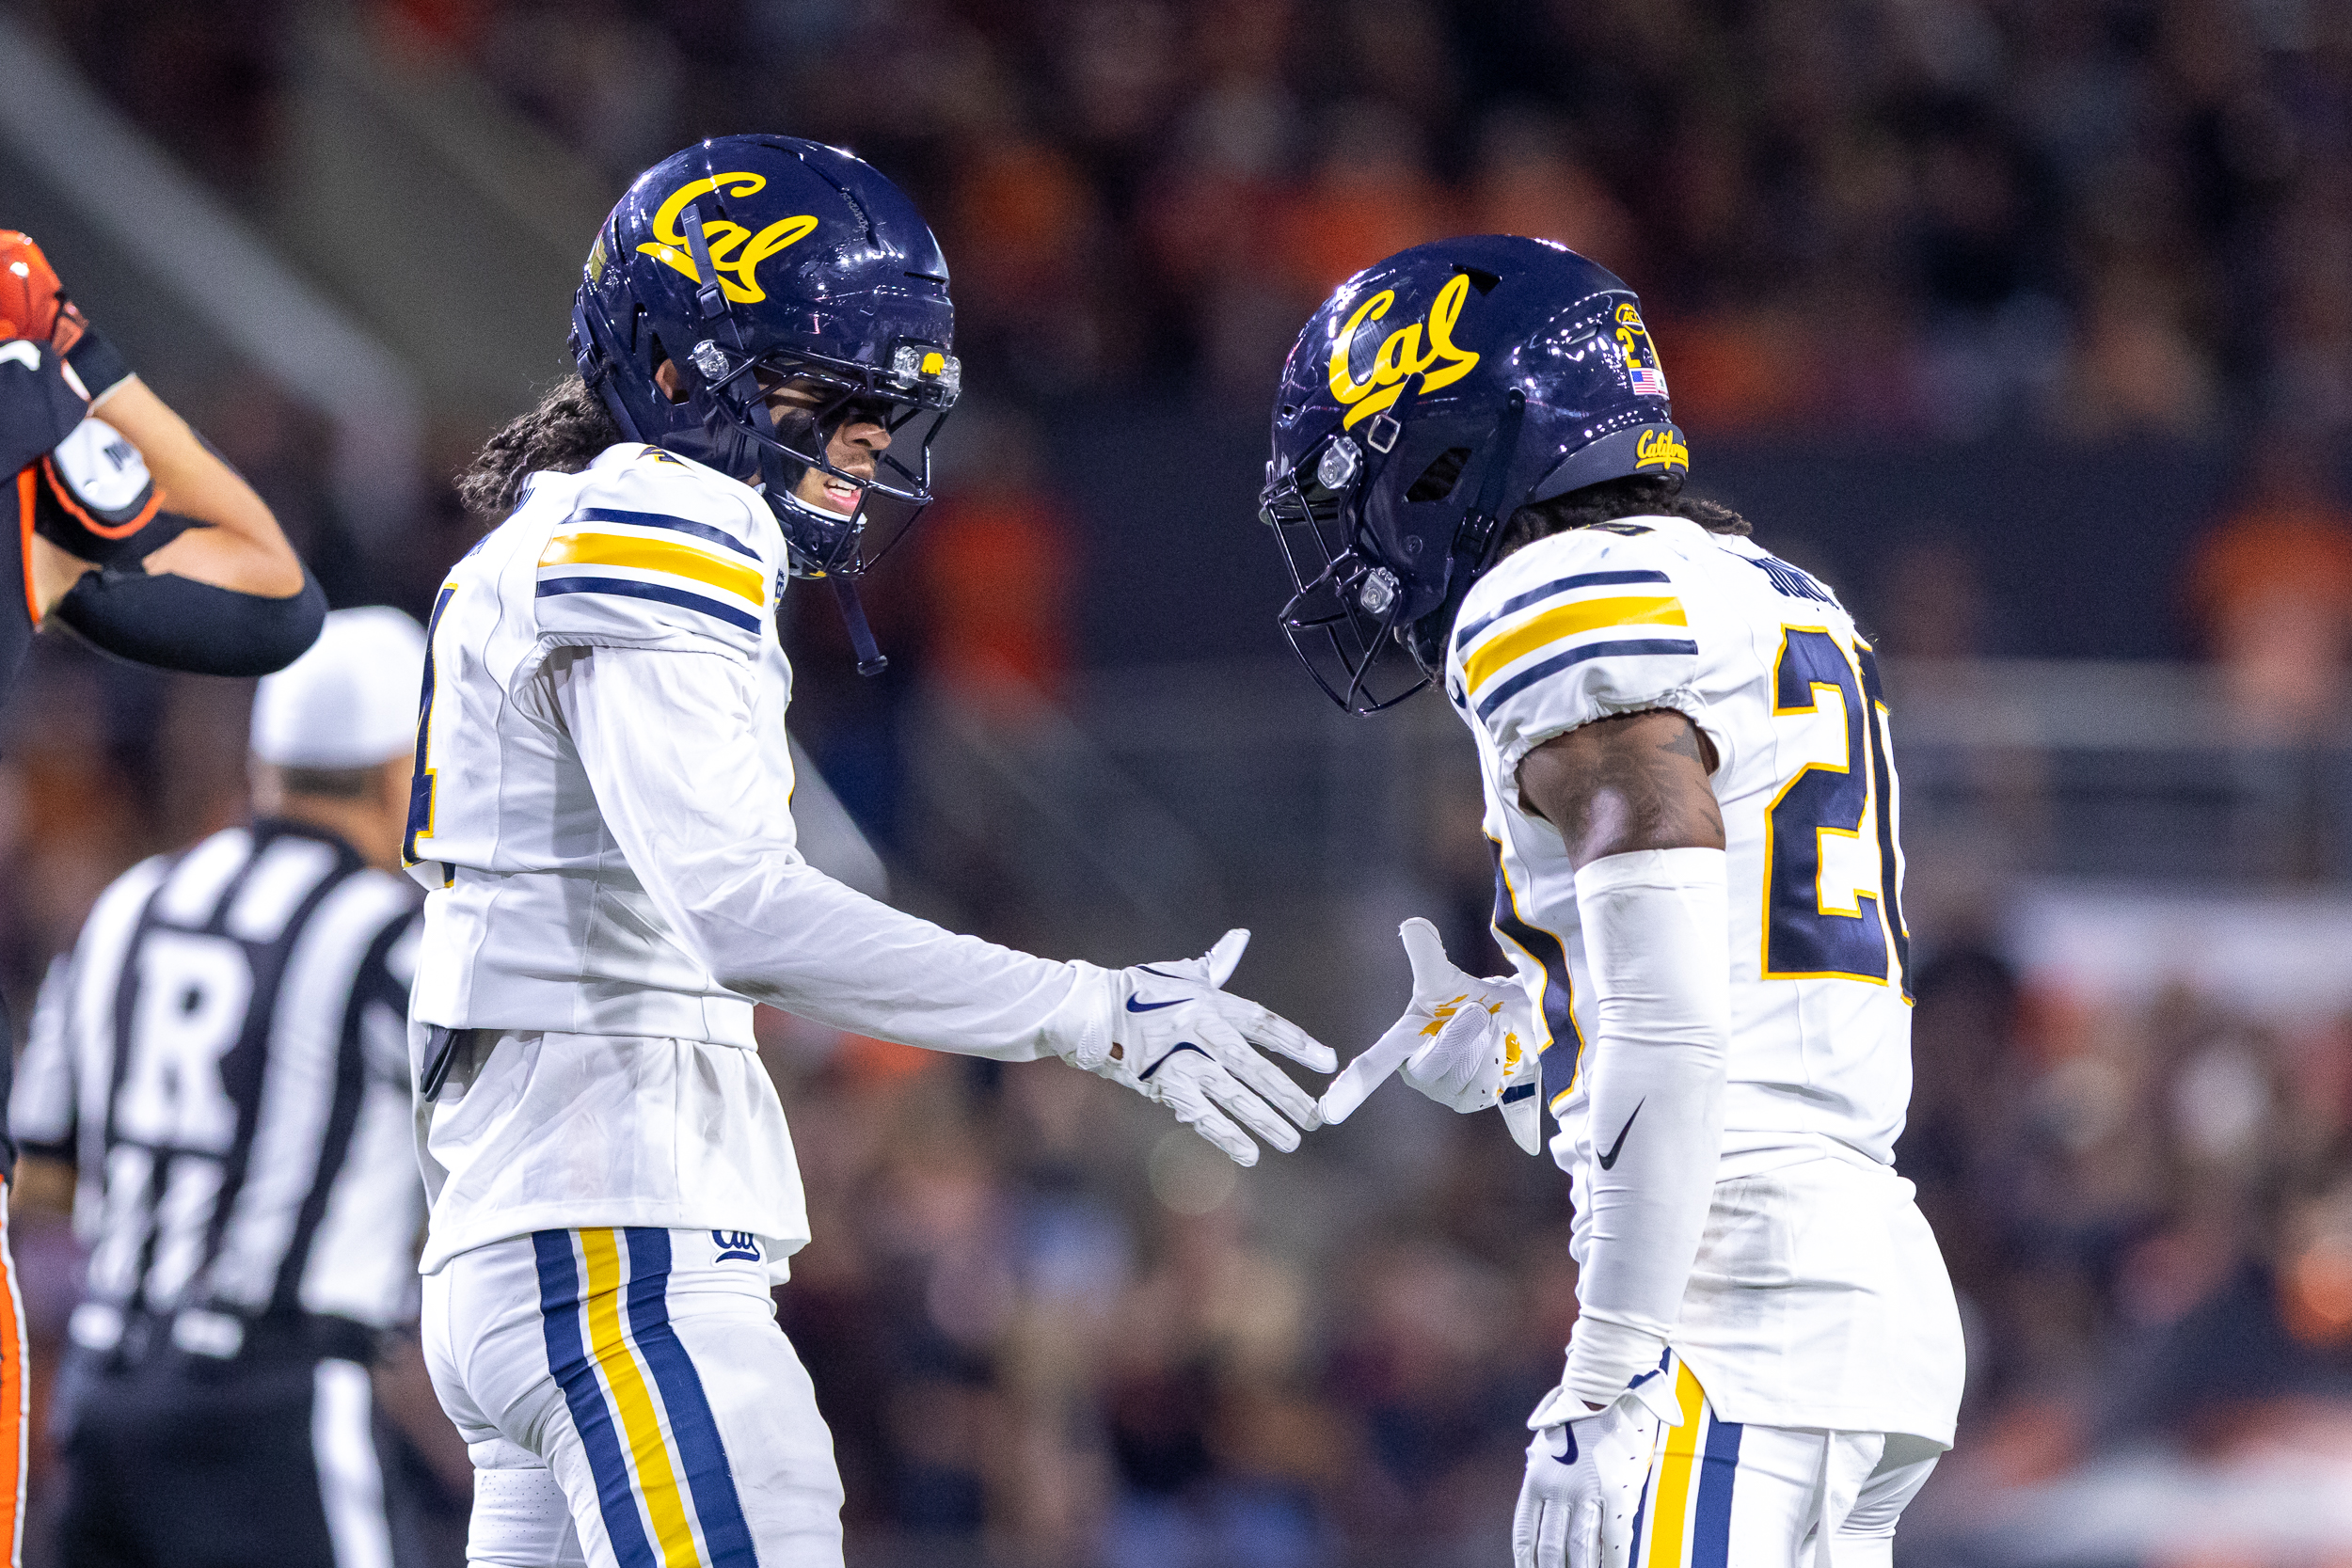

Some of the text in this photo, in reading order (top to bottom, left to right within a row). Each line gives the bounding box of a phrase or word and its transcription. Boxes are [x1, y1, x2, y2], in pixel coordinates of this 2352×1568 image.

[636, 171, 818, 304] Cal
[1328, 274, 1480, 431] Cal
[113, 928, 254, 1154] R
